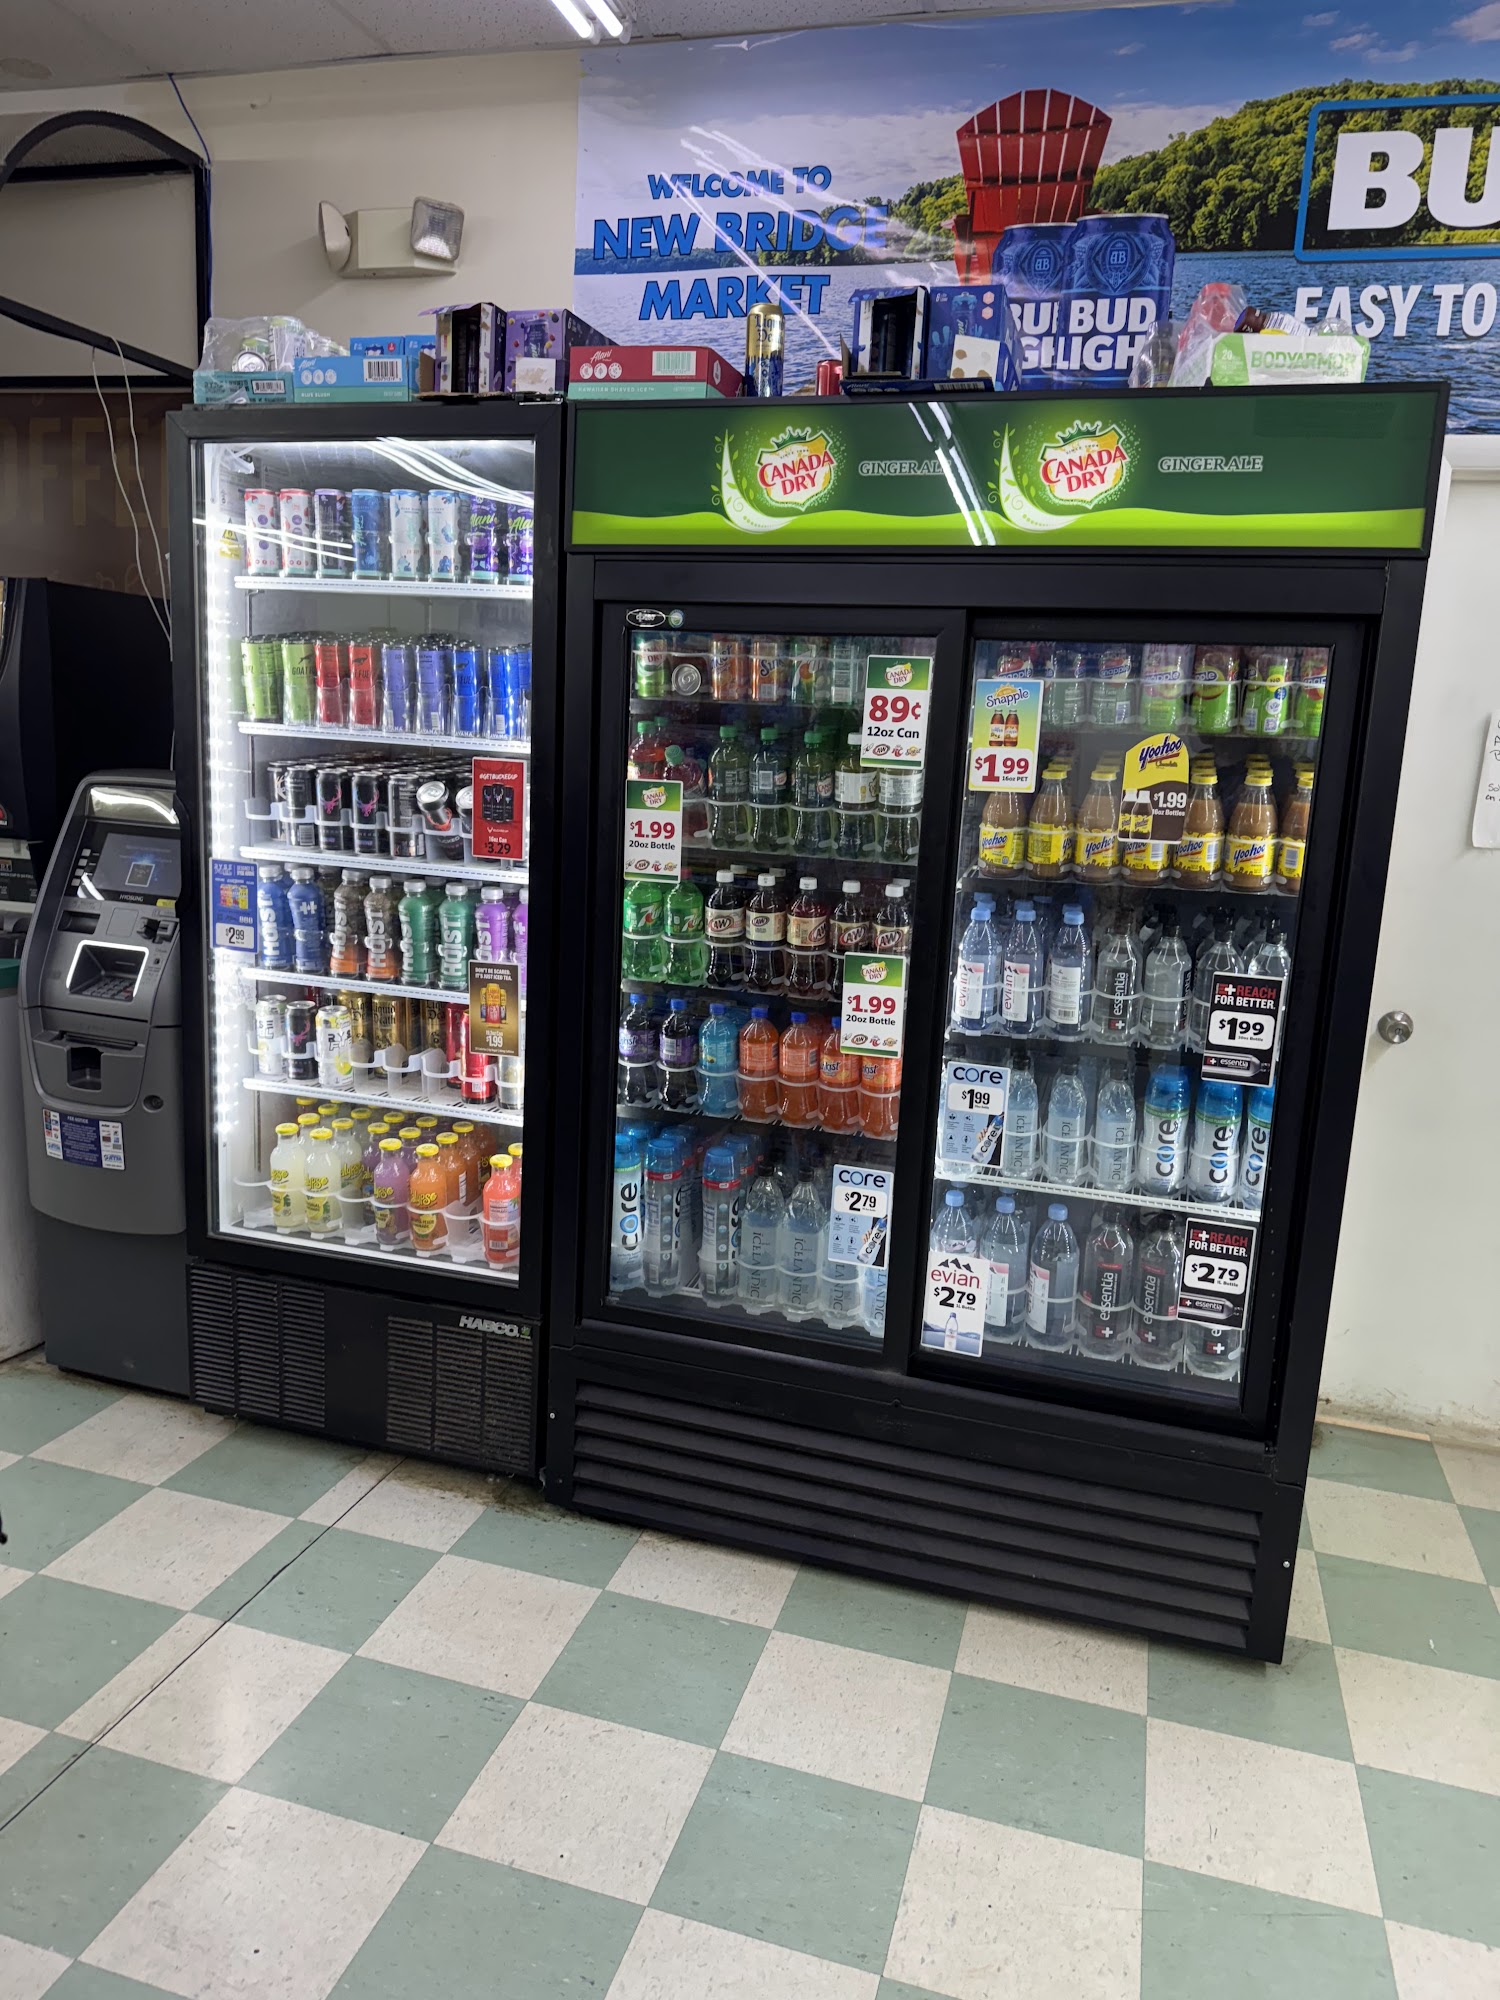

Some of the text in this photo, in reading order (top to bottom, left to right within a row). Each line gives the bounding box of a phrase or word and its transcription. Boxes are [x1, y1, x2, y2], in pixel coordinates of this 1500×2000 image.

[648, 166, 831, 199] WELCOME TO
[593, 205, 888, 259] NEW BRIDGE
[639, 275, 830, 320] MARKET
[1069, 298, 1156, 334] BUD
[1295, 283, 1497, 337] EASY TO
[1056, 335, 1147, 370] LIGH
[758, 451, 835, 488] CANADA
[859, 460, 918, 476] GINGER
[1041, 446, 1127, 485] CANADA
[1158, 455, 1264, 473] GINGER ALE
[781, 472, 817, 496] DRY
[1067, 467, 1107, 493] DRY
[986, 688, 1029, 708] Snapple
[869, 695, 922, 723] 89¢
[867, 726, 920, 739] 12oz Can
[1154, 792, 1187, 808] $1.99
[630, 820, 675, 840] $1.99
[484, 842, 511, 855] $3.29
[629, 840, 675, 850] 20oz Bottle
[368, 908, 386, 968] HOIST
[443, 916, 462, 976] HOIST
[475, 918, 493, 961] OIST
[1214, 994, 1276, 1010] FOR BETTER.
[1237, 985, 1277, 999] REACH
[847, 994, 896, 1015] $1.99
[846, 1014, 896, 1026] 20oz Bottle
[328, 1030, 351, 1043] RYS
[486, 1035, 503, 1048] $1.99
[1220, 1058, 1248, 1068] essentia
[953, 1066, 1003, 1084] core
[838, 1169, 886, 1188] core
[1189, 1240, 1248, 1257] FOR BETTER.
[1209, 1231, 1248, 1247] REACH
[931, 1268, 980, 1289] evian
[1100, 1272, 1114, 1321] essentia
[1195, 1300, 1222, 1310] essentia
